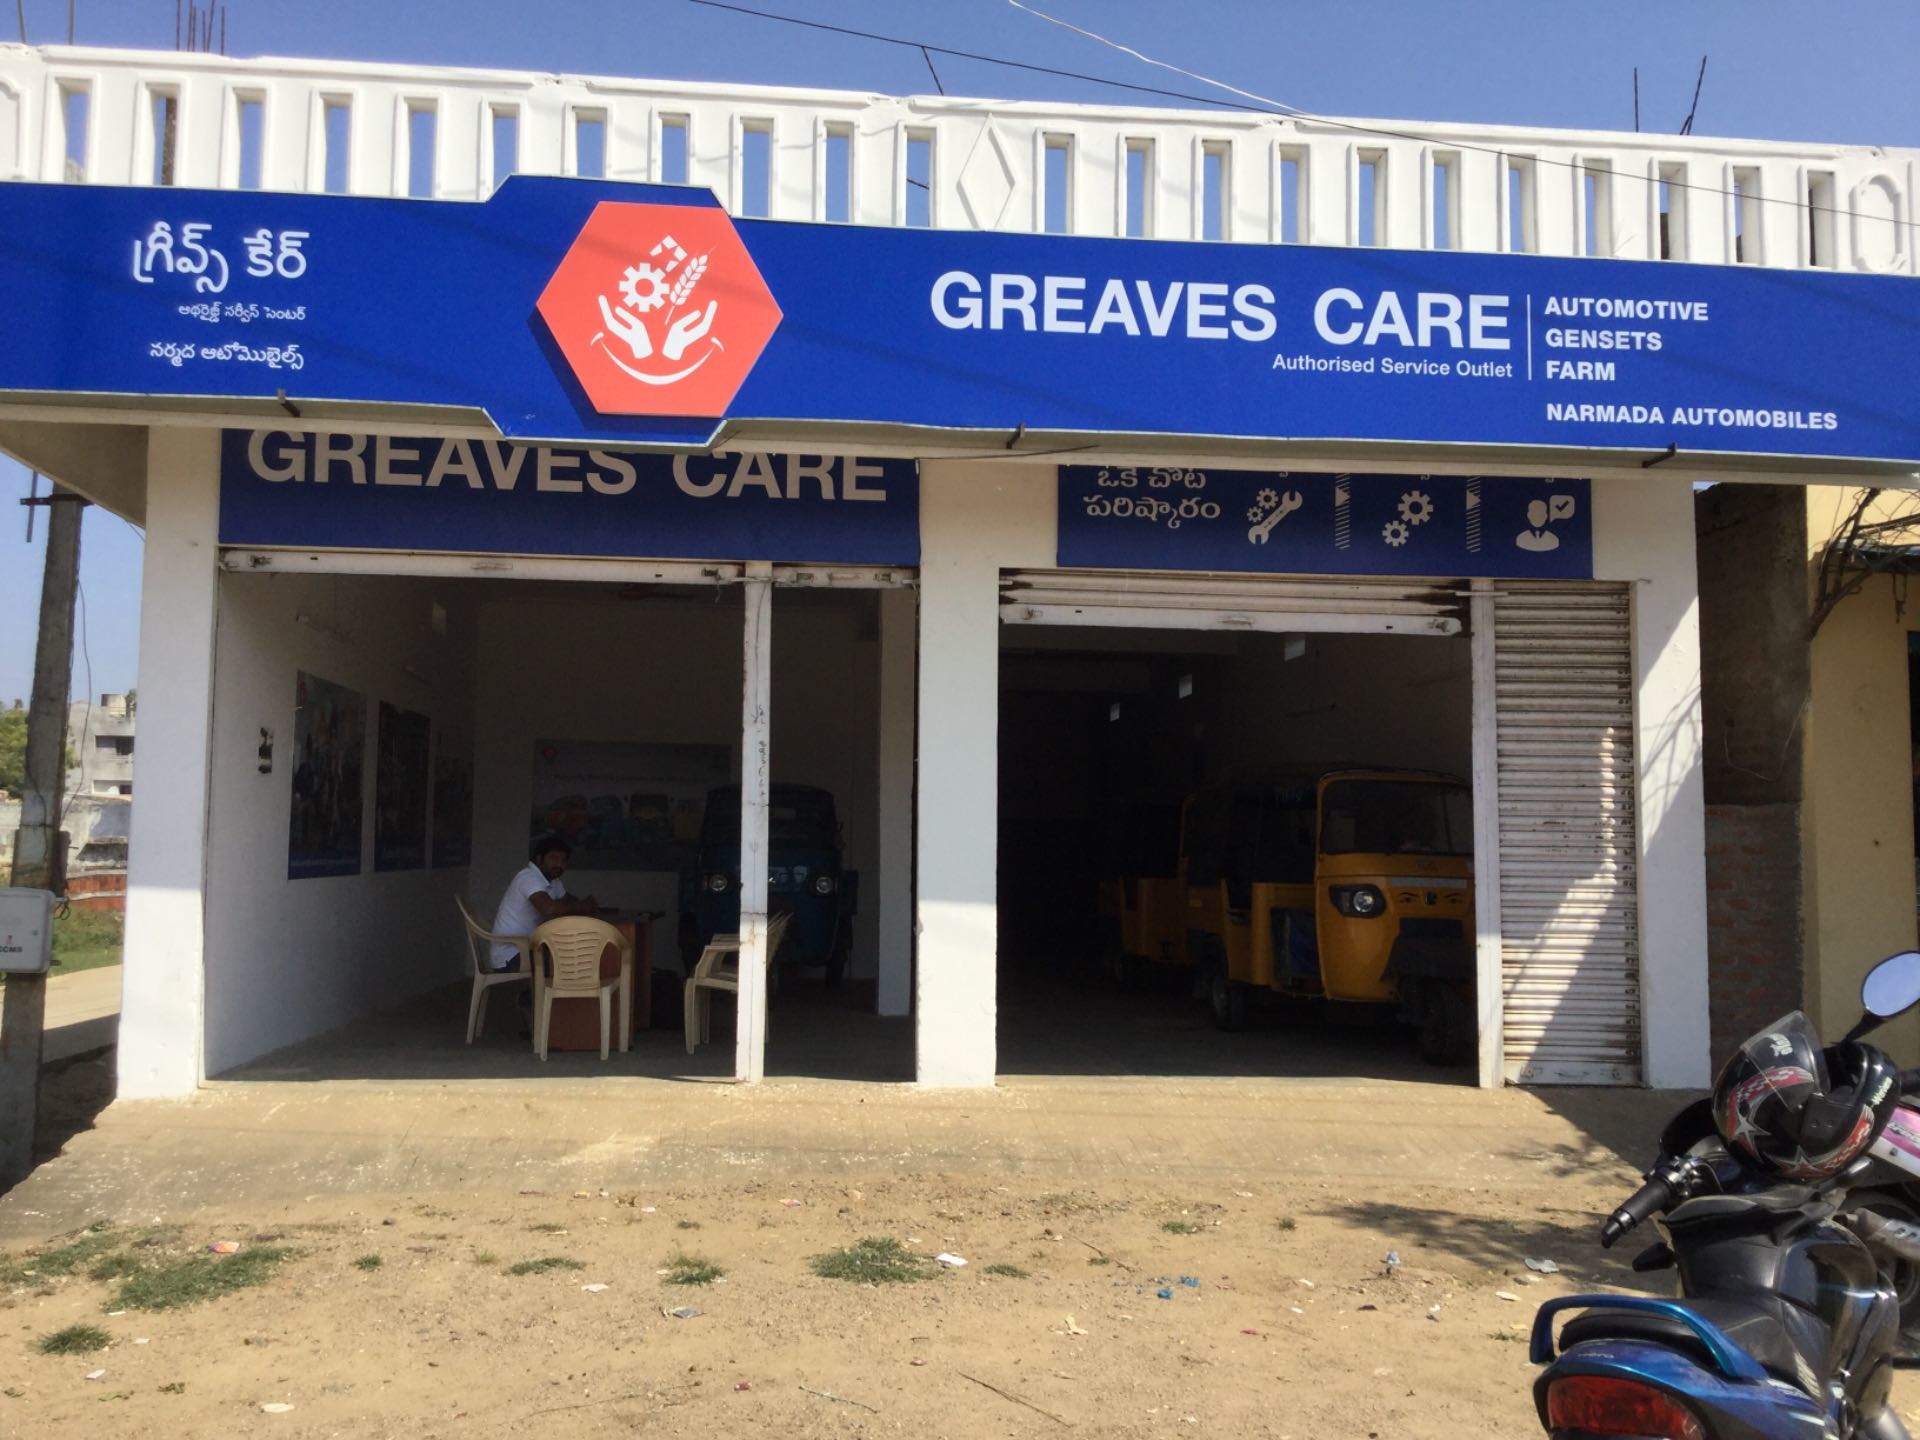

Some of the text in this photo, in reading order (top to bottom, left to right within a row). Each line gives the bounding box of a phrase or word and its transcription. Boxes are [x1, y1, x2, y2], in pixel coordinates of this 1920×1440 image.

[132, 220, 310, 294] గ్రీవ్స్ కేర్
[263, 306, 306, 321] సెంటర్
[930, 270, 1511, 350] GREAVES CARE
[1544, 296, 1709, 321] AUTOMOTIVE
[1545, 327, 1663, 351] GENSETS
[149, 341, 196, 367] నర్మద
[1272, 353, 1513, 378] Authorised Service Outlet
[1546, 359, 1616, 381] FARM
[1546, 403, 1838, 430] NARMADA AUTOMOBILES
[247, 431, 888, 503] GREAVES CARE
[1083, 494, 1221, 529] పరిష్కారం
